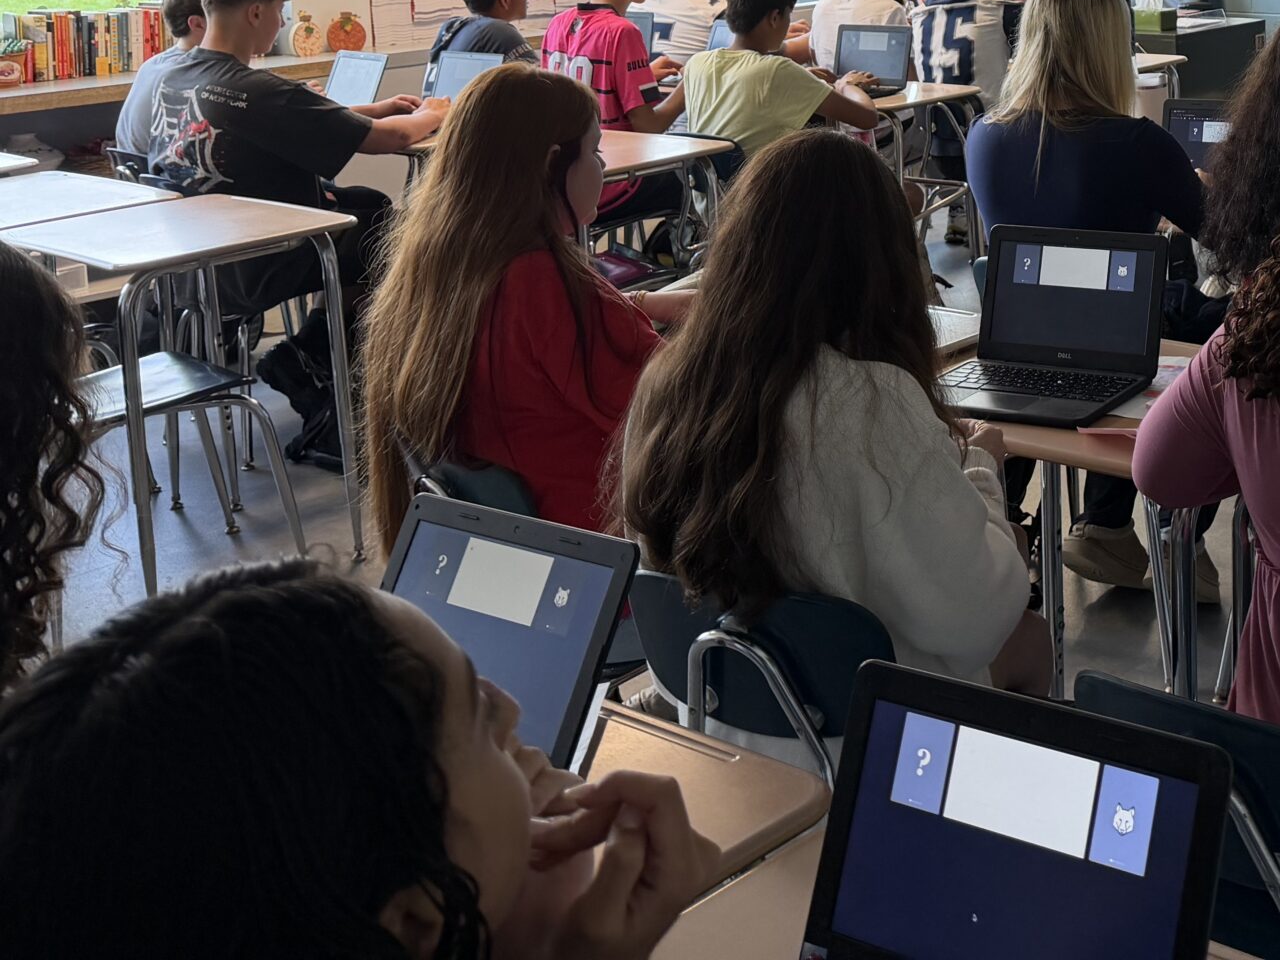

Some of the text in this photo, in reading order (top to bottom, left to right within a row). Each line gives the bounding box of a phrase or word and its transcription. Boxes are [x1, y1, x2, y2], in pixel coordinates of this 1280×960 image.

[921, 6, 975, 85] 15
[1023, 257, 1031, 270] ?
[435, 554, 448, 575] ?
[916, 748, 931, 776] ?
